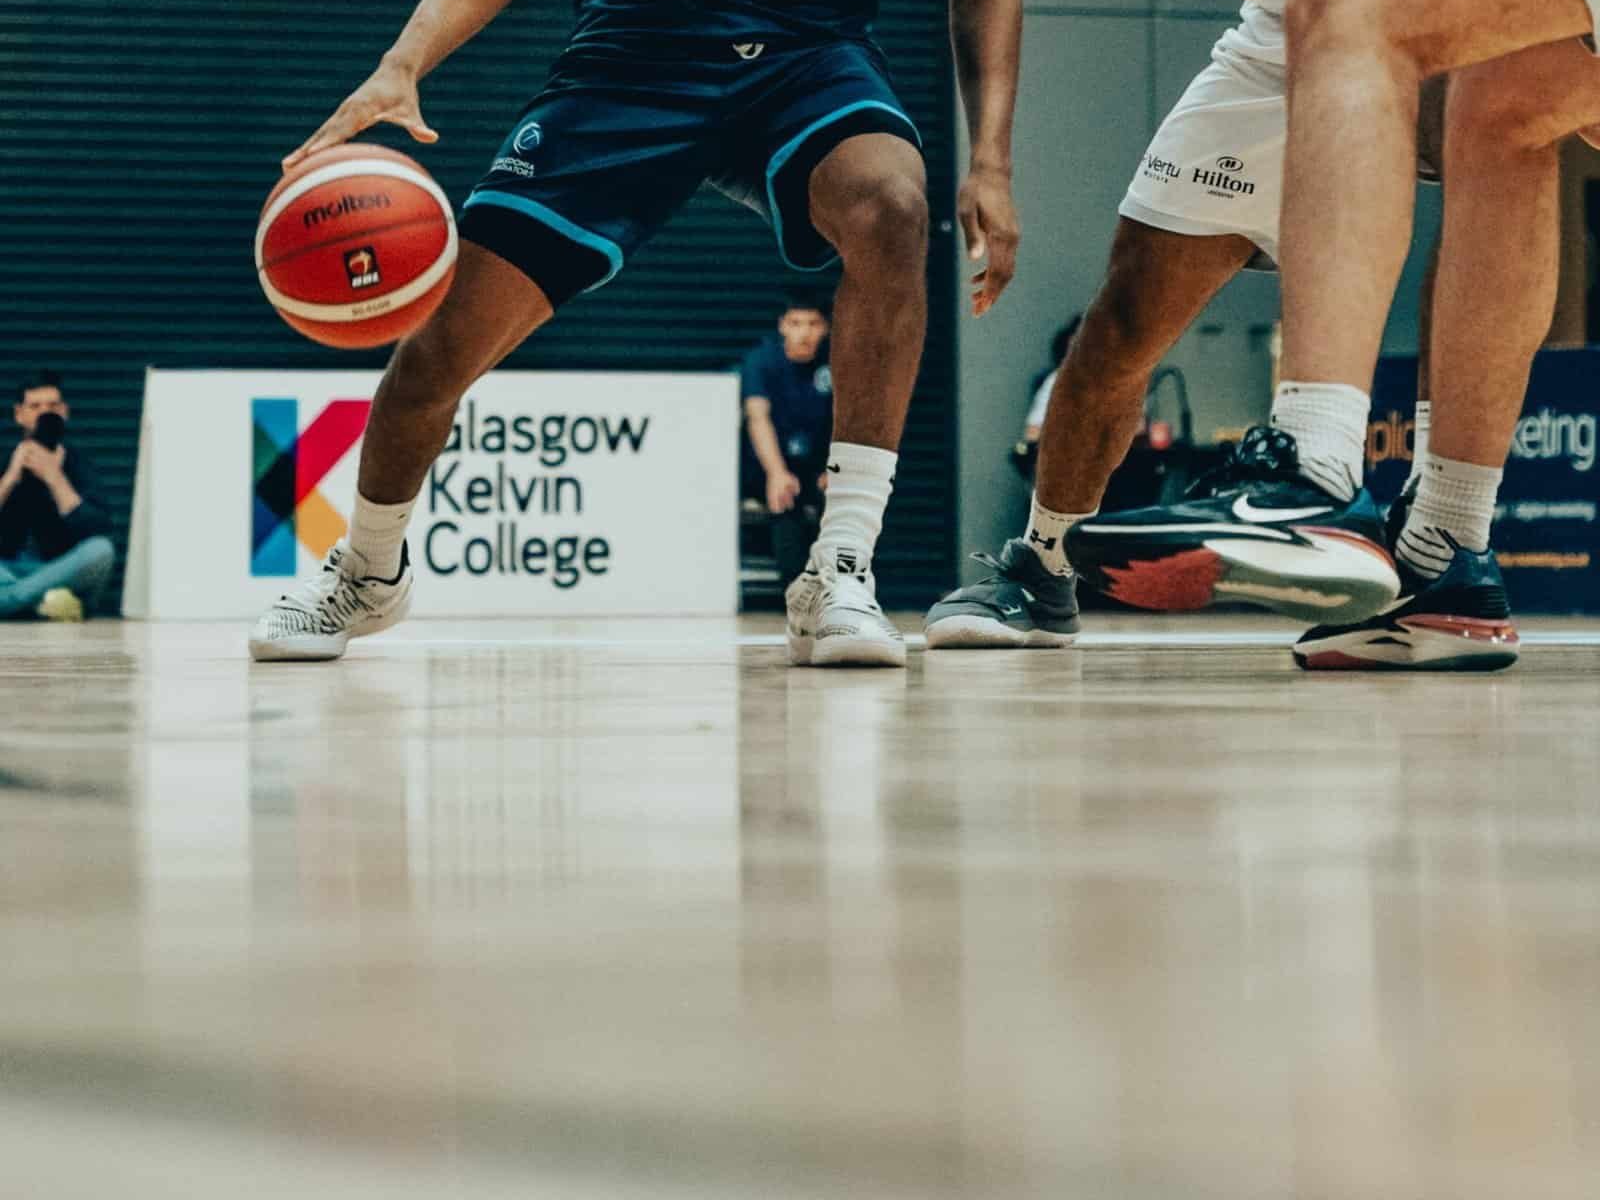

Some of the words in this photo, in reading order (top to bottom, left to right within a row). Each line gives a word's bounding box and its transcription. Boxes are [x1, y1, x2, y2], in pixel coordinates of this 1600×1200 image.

[1147, 153, 1181, 178] Vertu
[1192, 167, 1255, 195] Hilton
[303, 193, 391, 230] molten
[429, 460, 583, 515] Kelvin
[425, 520, 611, 590] College
